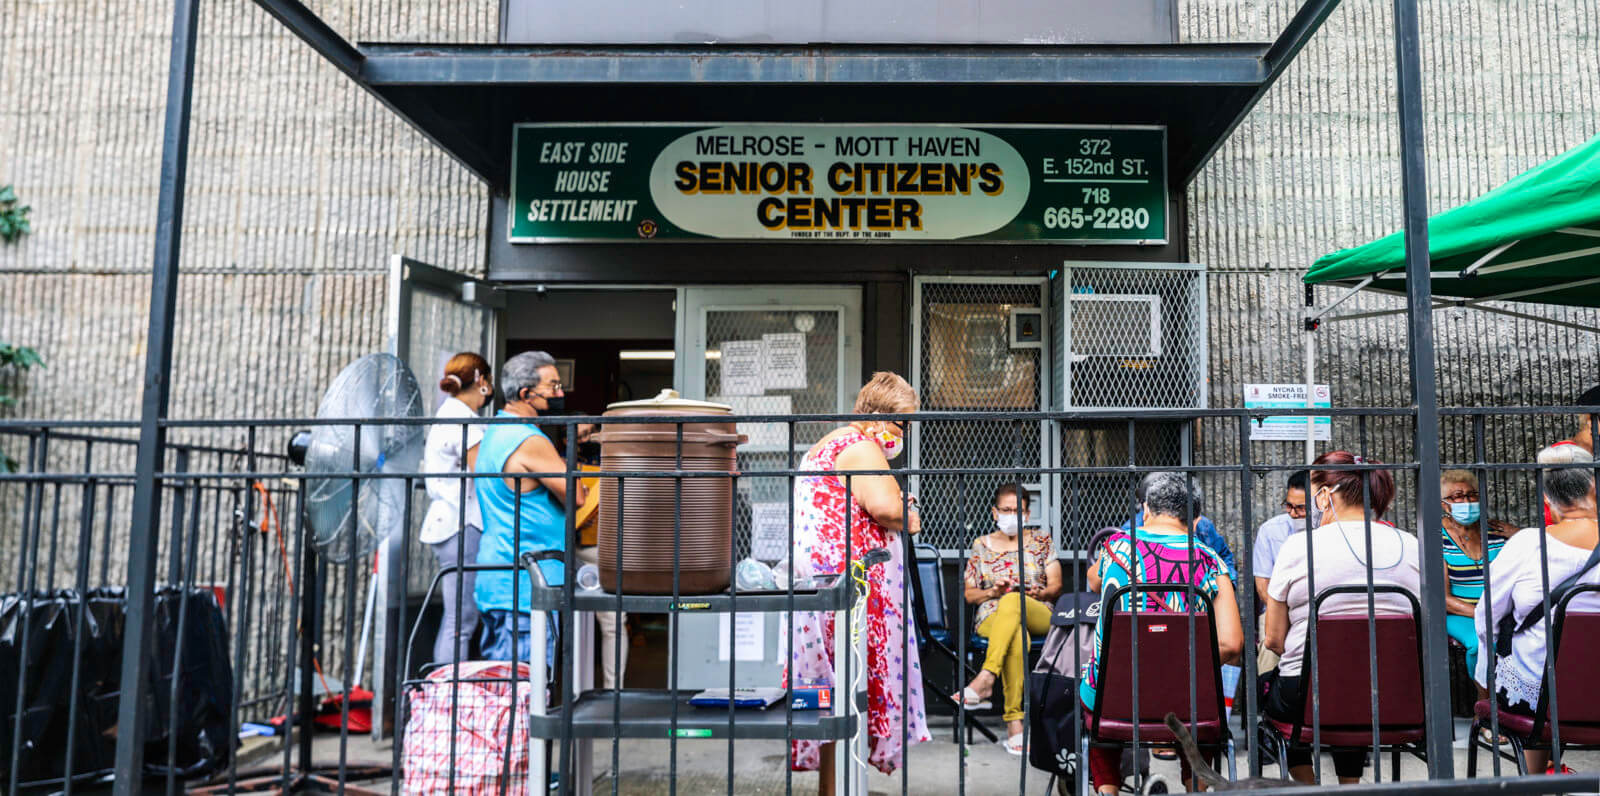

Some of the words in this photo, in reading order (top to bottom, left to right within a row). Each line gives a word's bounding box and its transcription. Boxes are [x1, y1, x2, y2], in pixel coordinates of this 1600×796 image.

[540, 142, 583, 164] EAST
[588, 142, 629, 164] SIDE
[696, 136, 805, 156] MELROSE
[835, 137, 899, 157] MOTT
[908, 137, 981, 157] HAVEN
[1080, 139, 1111, 155] 372
[1043, 158, 1059, 174] E.
[1065, 158, 1114, 175] 152nd
[1121, 160, 1149, 175] ST.
[555, 171, 611, 193] HOUSE
[674, 161, 814, 195] SENIOR
[827, 162, 1005, 195] CITIZEN'S
[1082, 188, 1110, 204] 718
[528, 200, 638, 222] SETTLEMENT
[756, 197, 923, 231] CENTER
[1043, 207, 1150, 229] 665-2280
